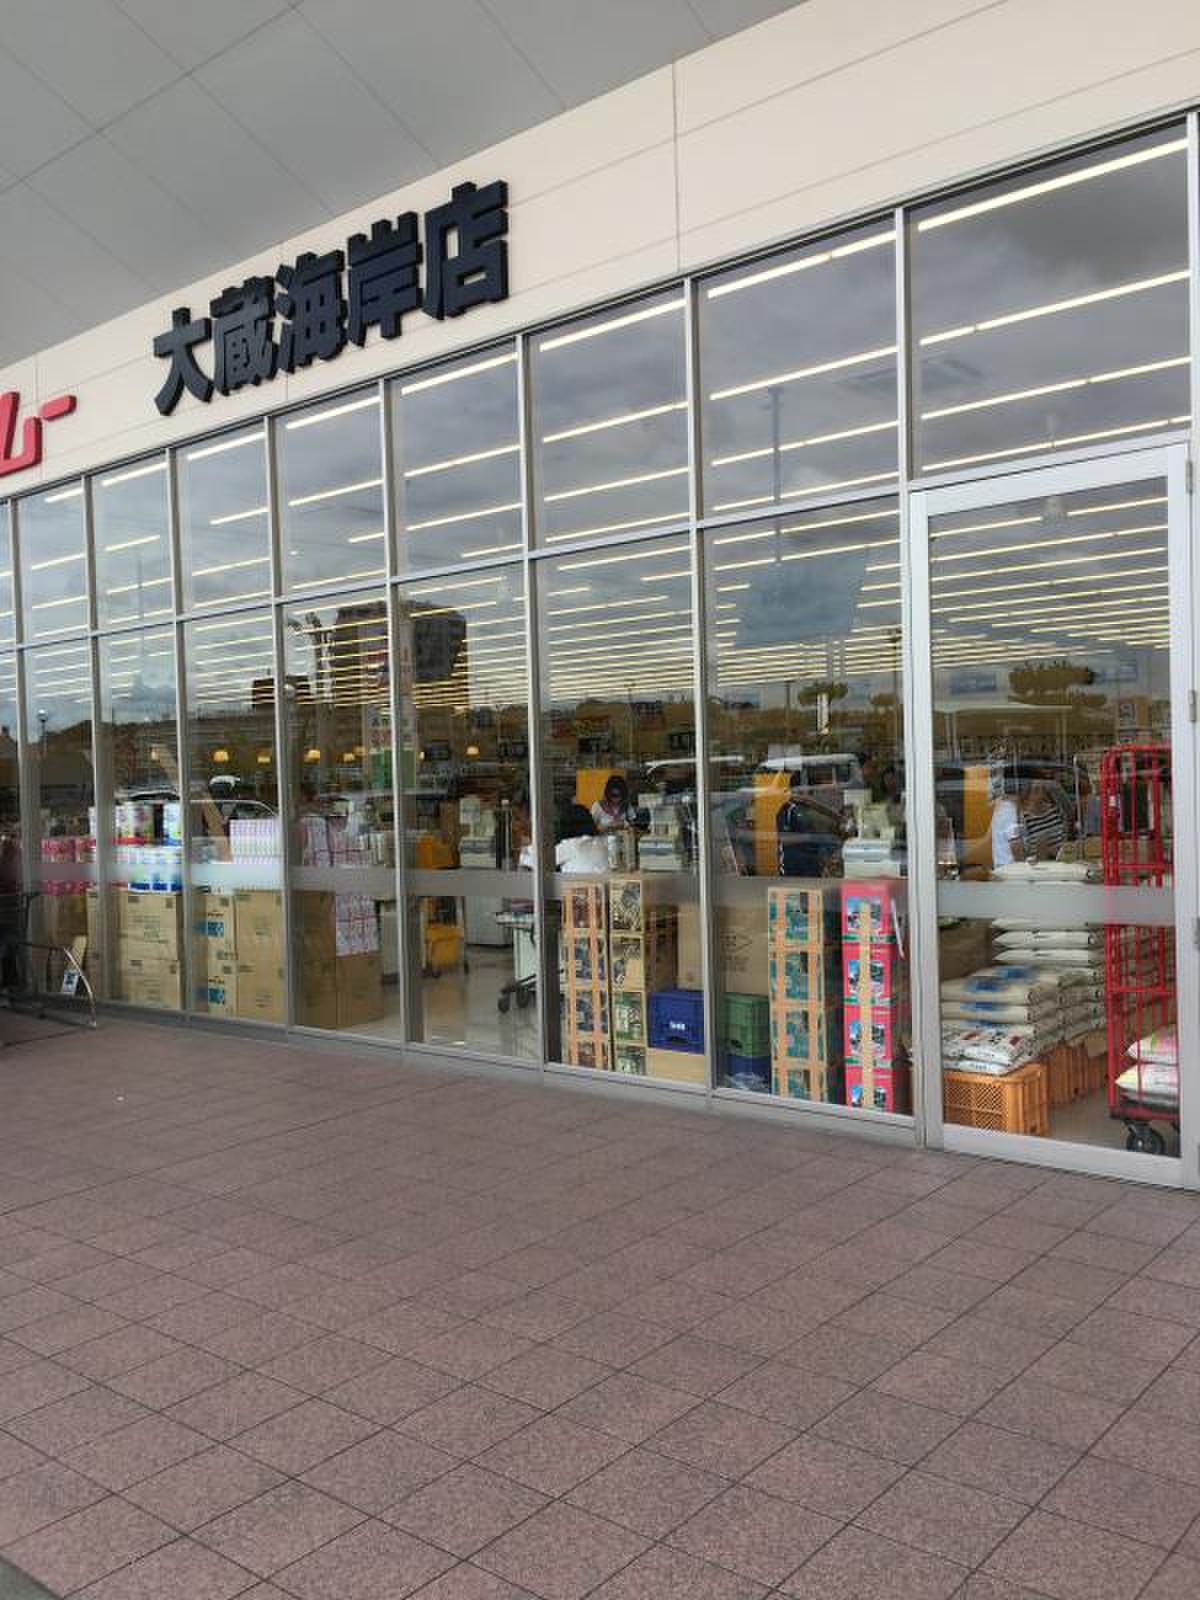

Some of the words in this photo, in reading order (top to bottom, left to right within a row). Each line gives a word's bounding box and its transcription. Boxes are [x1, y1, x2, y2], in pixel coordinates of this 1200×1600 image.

[153, 180, 509, 416] 大蔵海岸店
